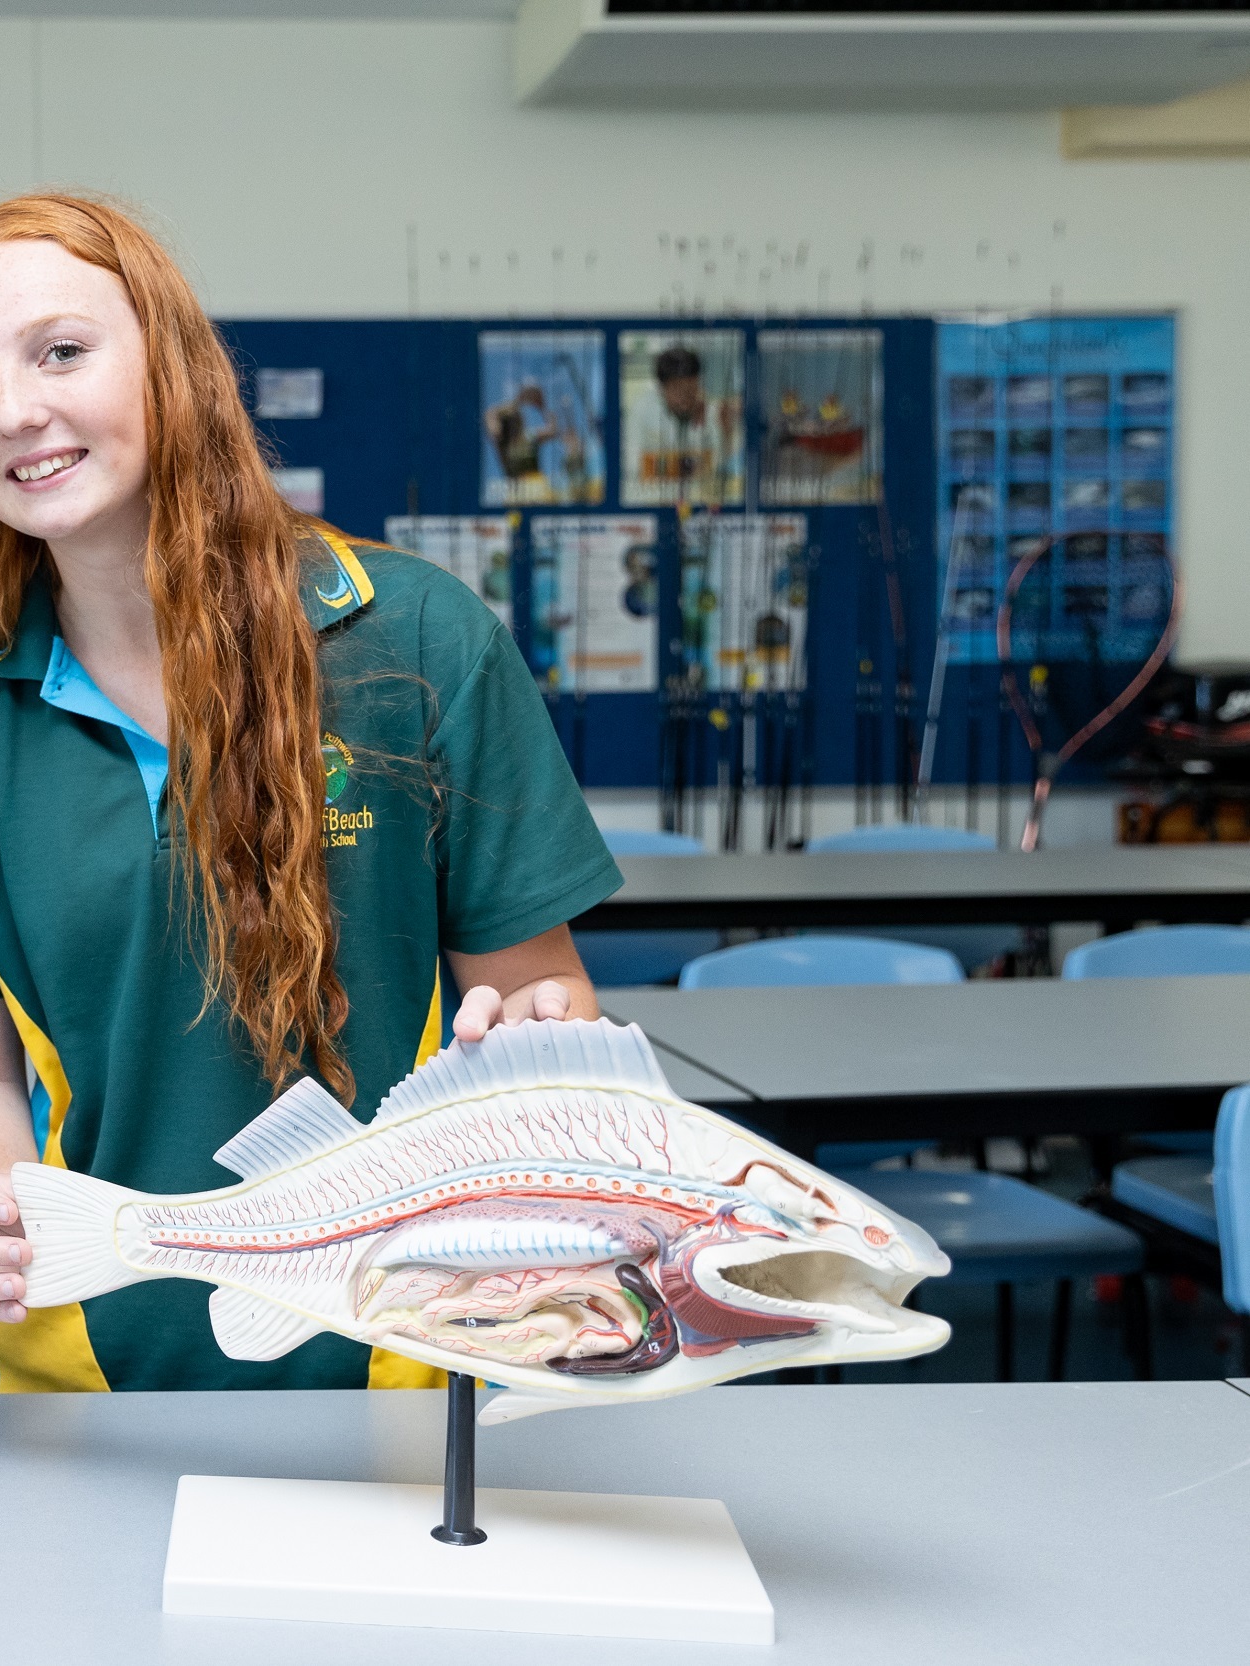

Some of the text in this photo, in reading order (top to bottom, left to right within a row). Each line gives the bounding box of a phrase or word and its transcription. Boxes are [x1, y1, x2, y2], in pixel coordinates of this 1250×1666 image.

[324, 731, 354, 766] Pathways
[330, 831, 358, 847] School
[465, 1316, 478, 1328] 19
[647, 1341, 661, 1355] 13
